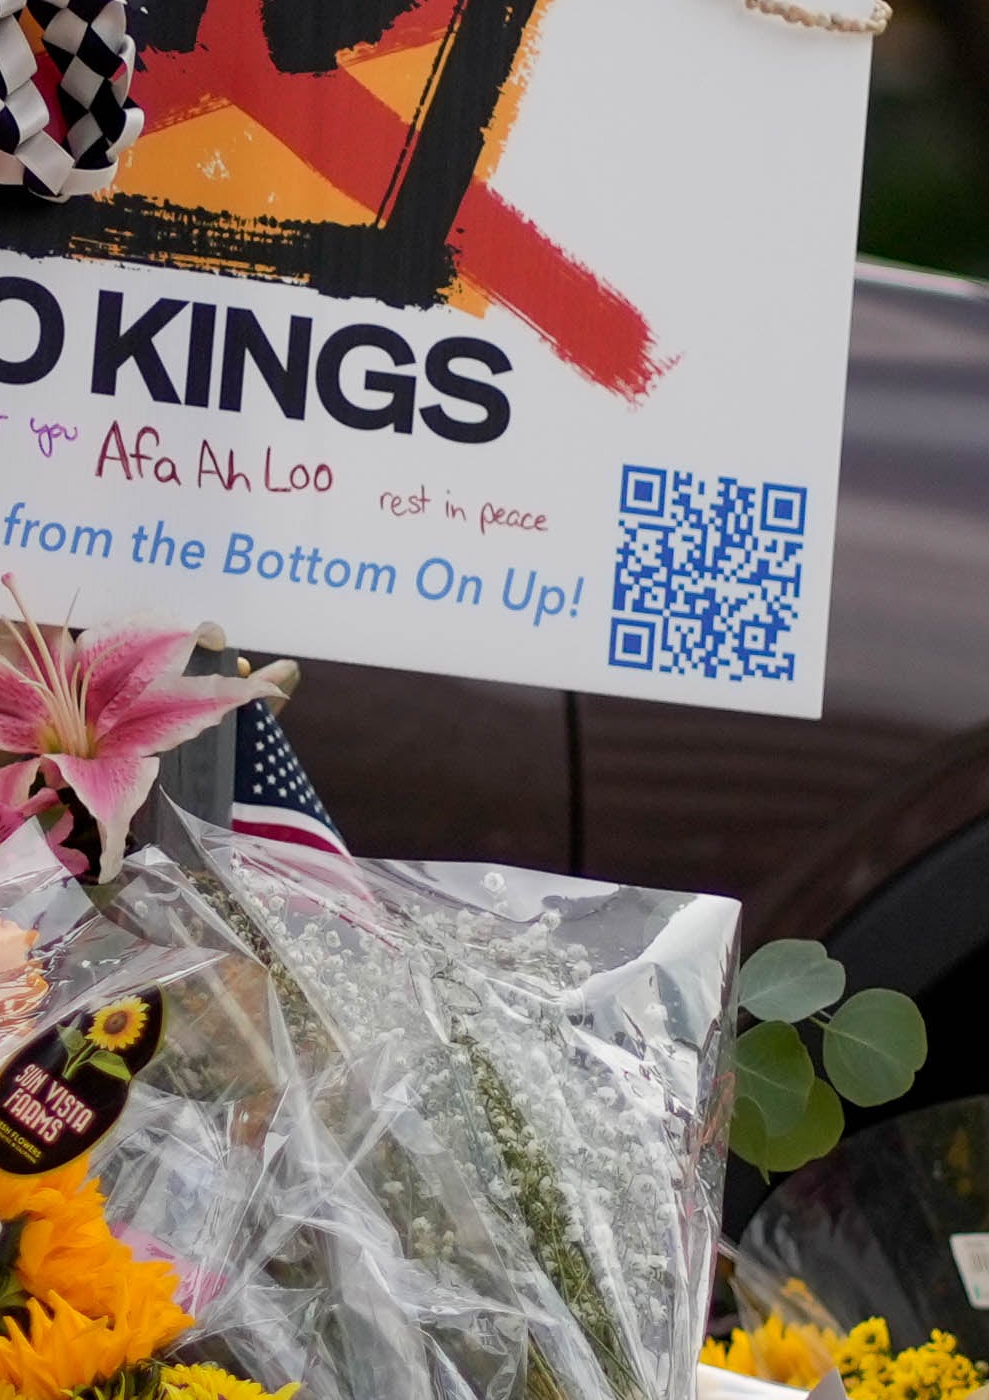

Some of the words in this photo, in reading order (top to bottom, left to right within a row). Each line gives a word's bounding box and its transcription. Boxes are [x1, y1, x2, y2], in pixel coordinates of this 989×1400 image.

[90, 288, 514, 445] KINGS
[29, 417, 78, 458] you
[95, 419, 181, 486] Afa
[197, 439, 251, 493] Ah
[264, 446, 333, 493] Loo
[379, 484, 432, 517] rest
[445, 489, 466, 521] in
[479, 502, 549, 535] peace
[3, 501, 113, 558] from
[131, 520, 206, 570] the
[222, 532, 398, 594] Bottom
[416, 557, 483, 606] On
[502, 567, 585, 627] Up!
[2, 1087, 65, 1144] FARMS
[14, 1062, 48, 1095] SUN
[42, 1082, 96, 1134] VISTA
